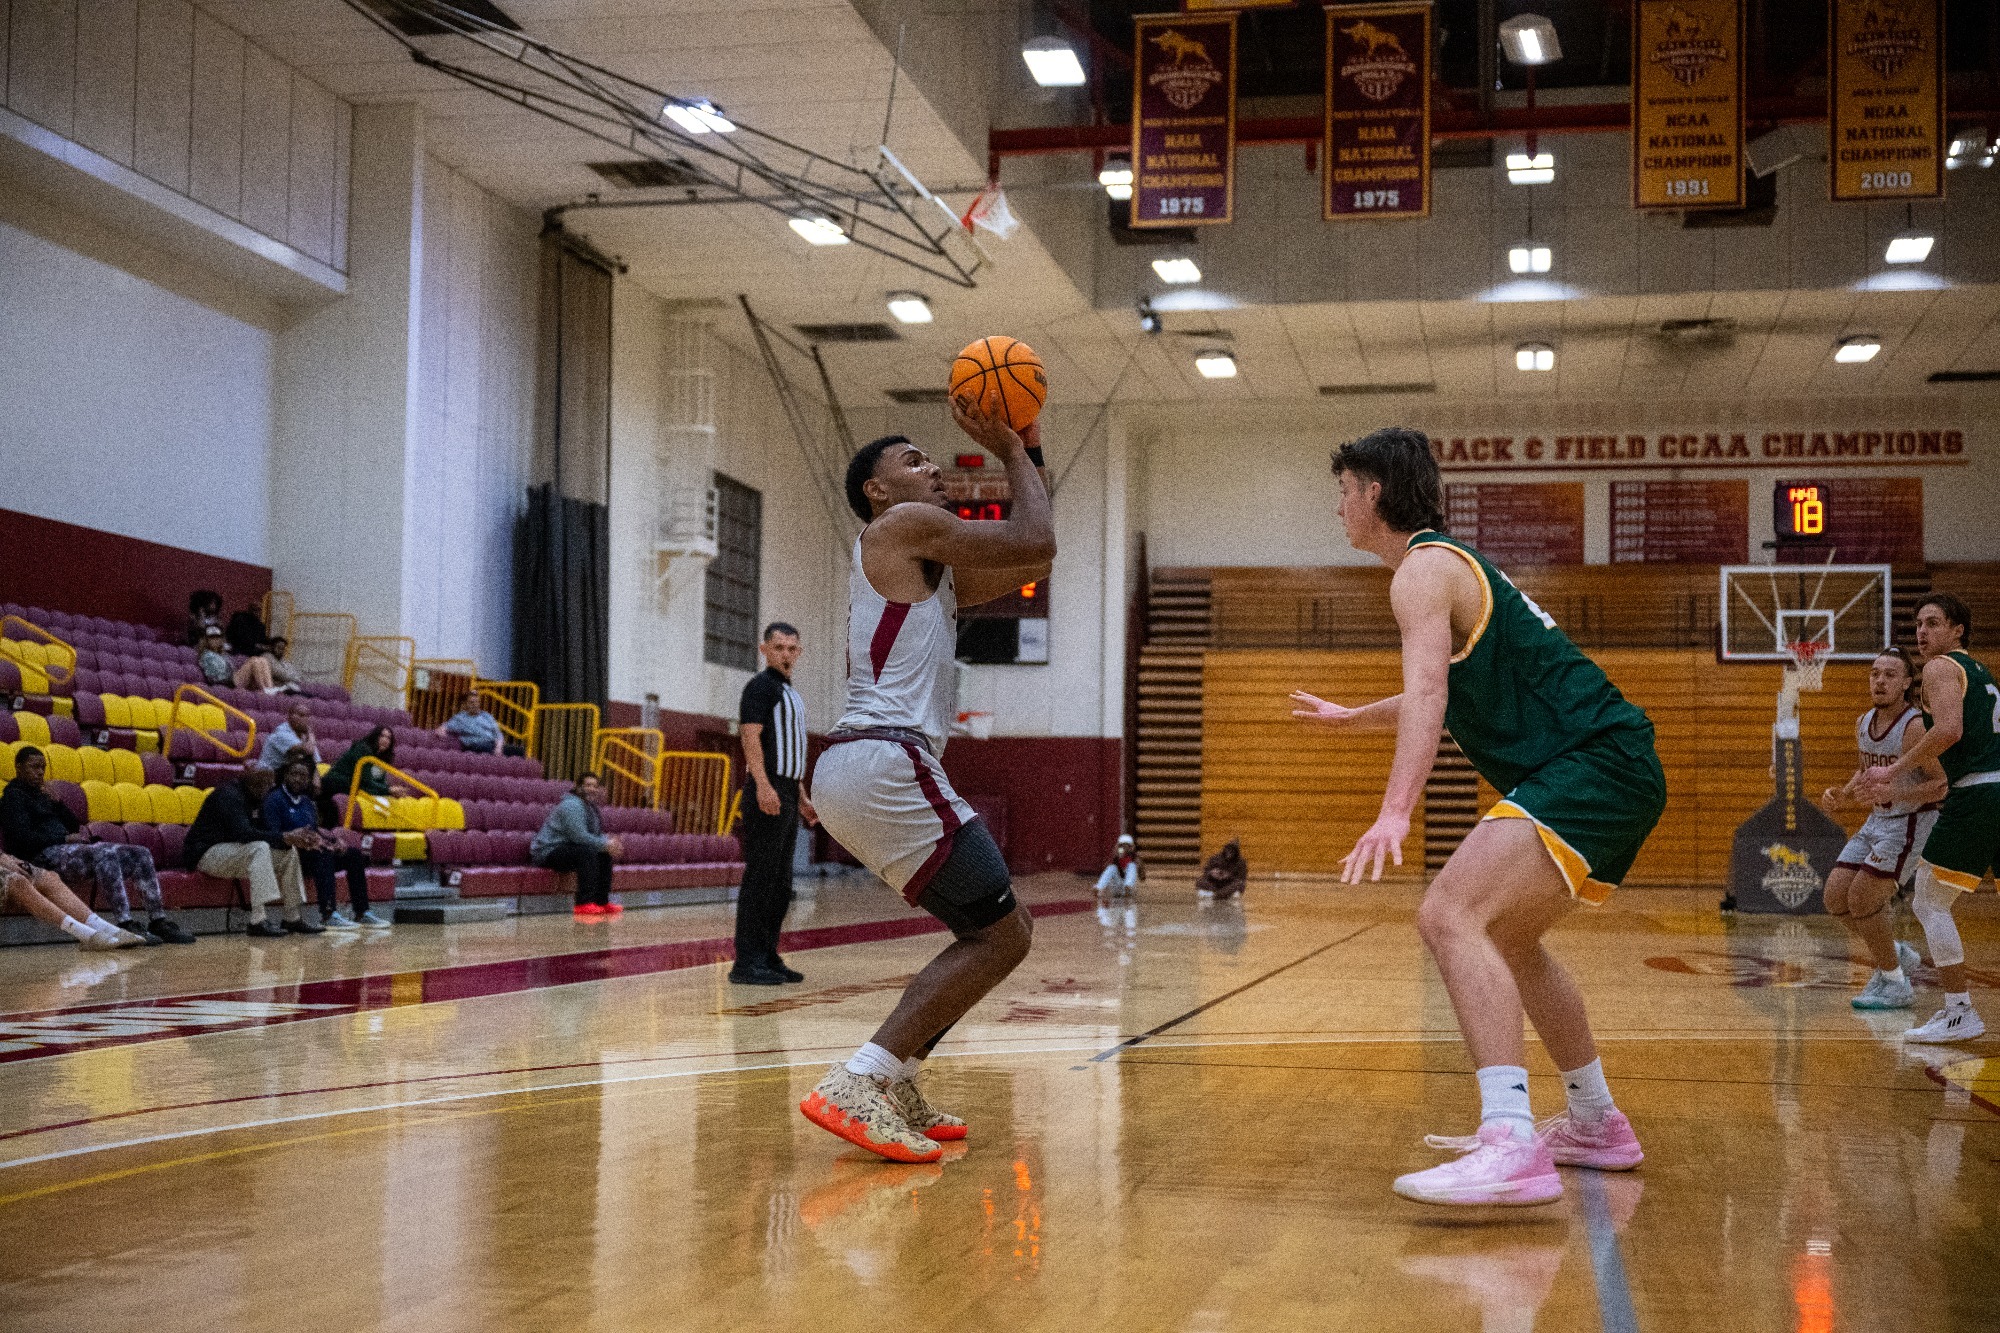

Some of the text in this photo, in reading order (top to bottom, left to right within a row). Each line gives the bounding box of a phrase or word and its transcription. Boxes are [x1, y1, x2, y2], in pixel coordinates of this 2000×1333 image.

[1666, 113, 1710, 128] NCAA
[1863, 104, 1909, 120] NCAA
[1648, 133, 1727, 149] NATIONAL
[1845, 124, 1926, 141] NATIONAL
[1146, 153, 1220, 170] NATIONAL
[1338, 145, 1415, 162] NATIONAL
[1643, 153, 1732, 170] CHAMPIONS
[1840, 145, 1931, 163] CHAMPIONS
[1665, 179, 1710, 197] 1991
[1860, 171, 1913, 190] 2000
[1159, 197, 1205, 215] 1975
[1353, 191, 1400, 209] 1975
[1554, 436, 1646, 460] FIELD
[1658, 435, 1750, 460] CCAA
[1762, 431, 1964, 458] CHAMPIONS
[1794, 501, 1823, 534] 18
